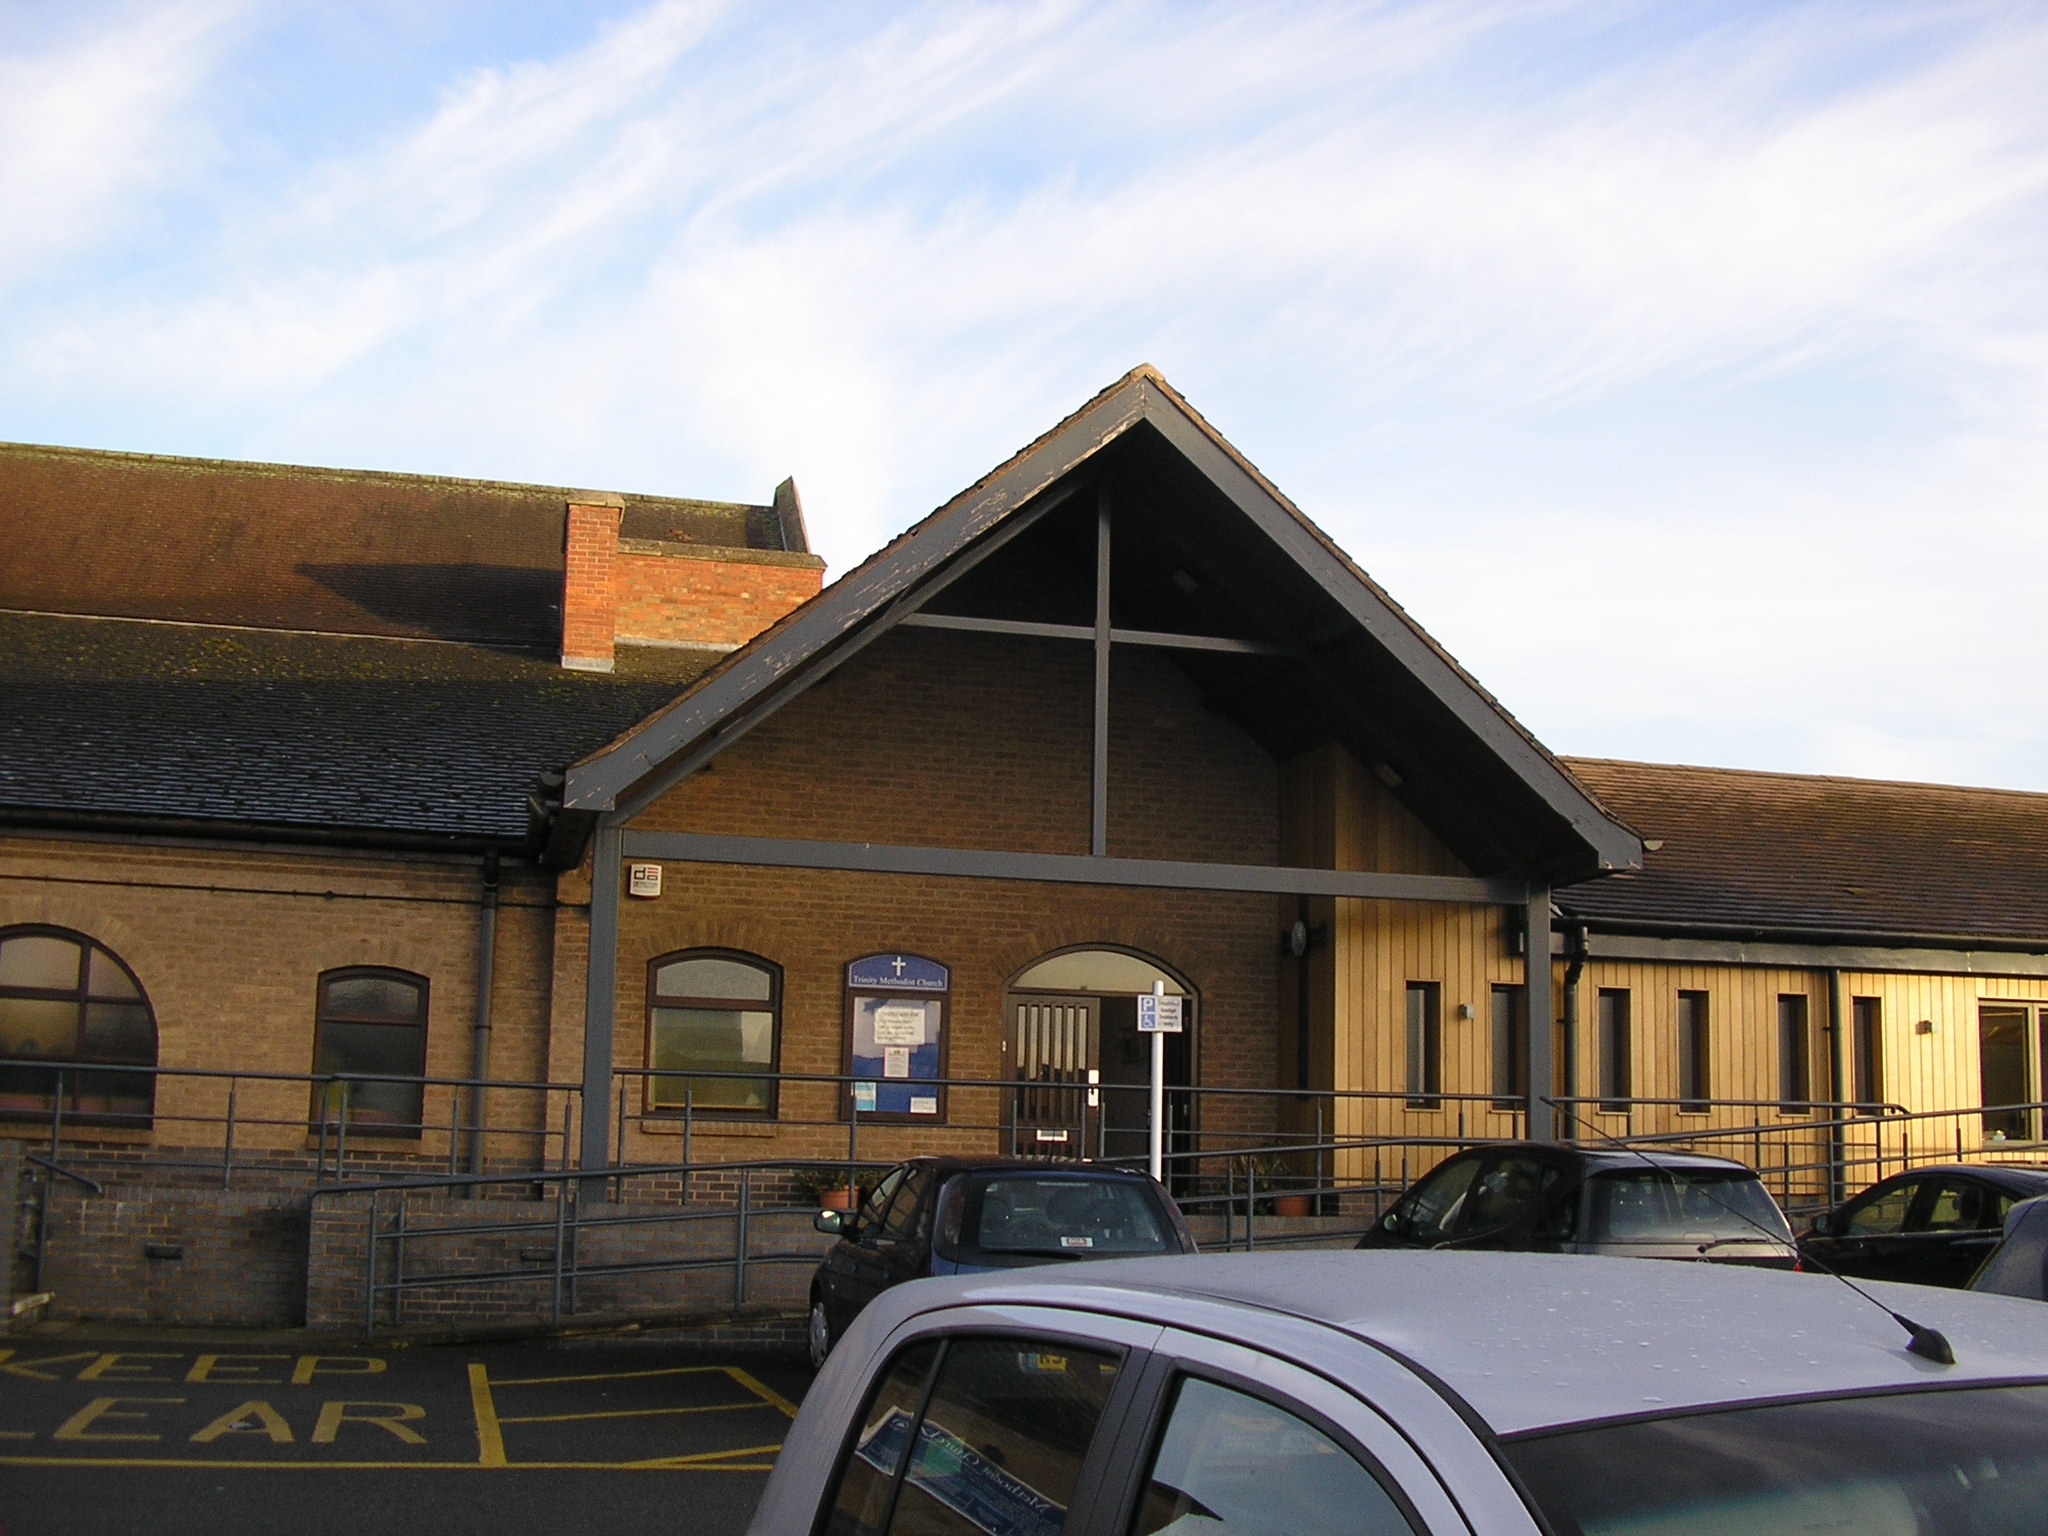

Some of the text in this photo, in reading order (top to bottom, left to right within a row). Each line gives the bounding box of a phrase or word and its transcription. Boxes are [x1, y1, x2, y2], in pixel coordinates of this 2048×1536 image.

[853, 975, 943, 987] Trinity Methodist Church
[0, 1349, 388, 1384] KEEP
[0, 1397, 428, 1444] EAR
